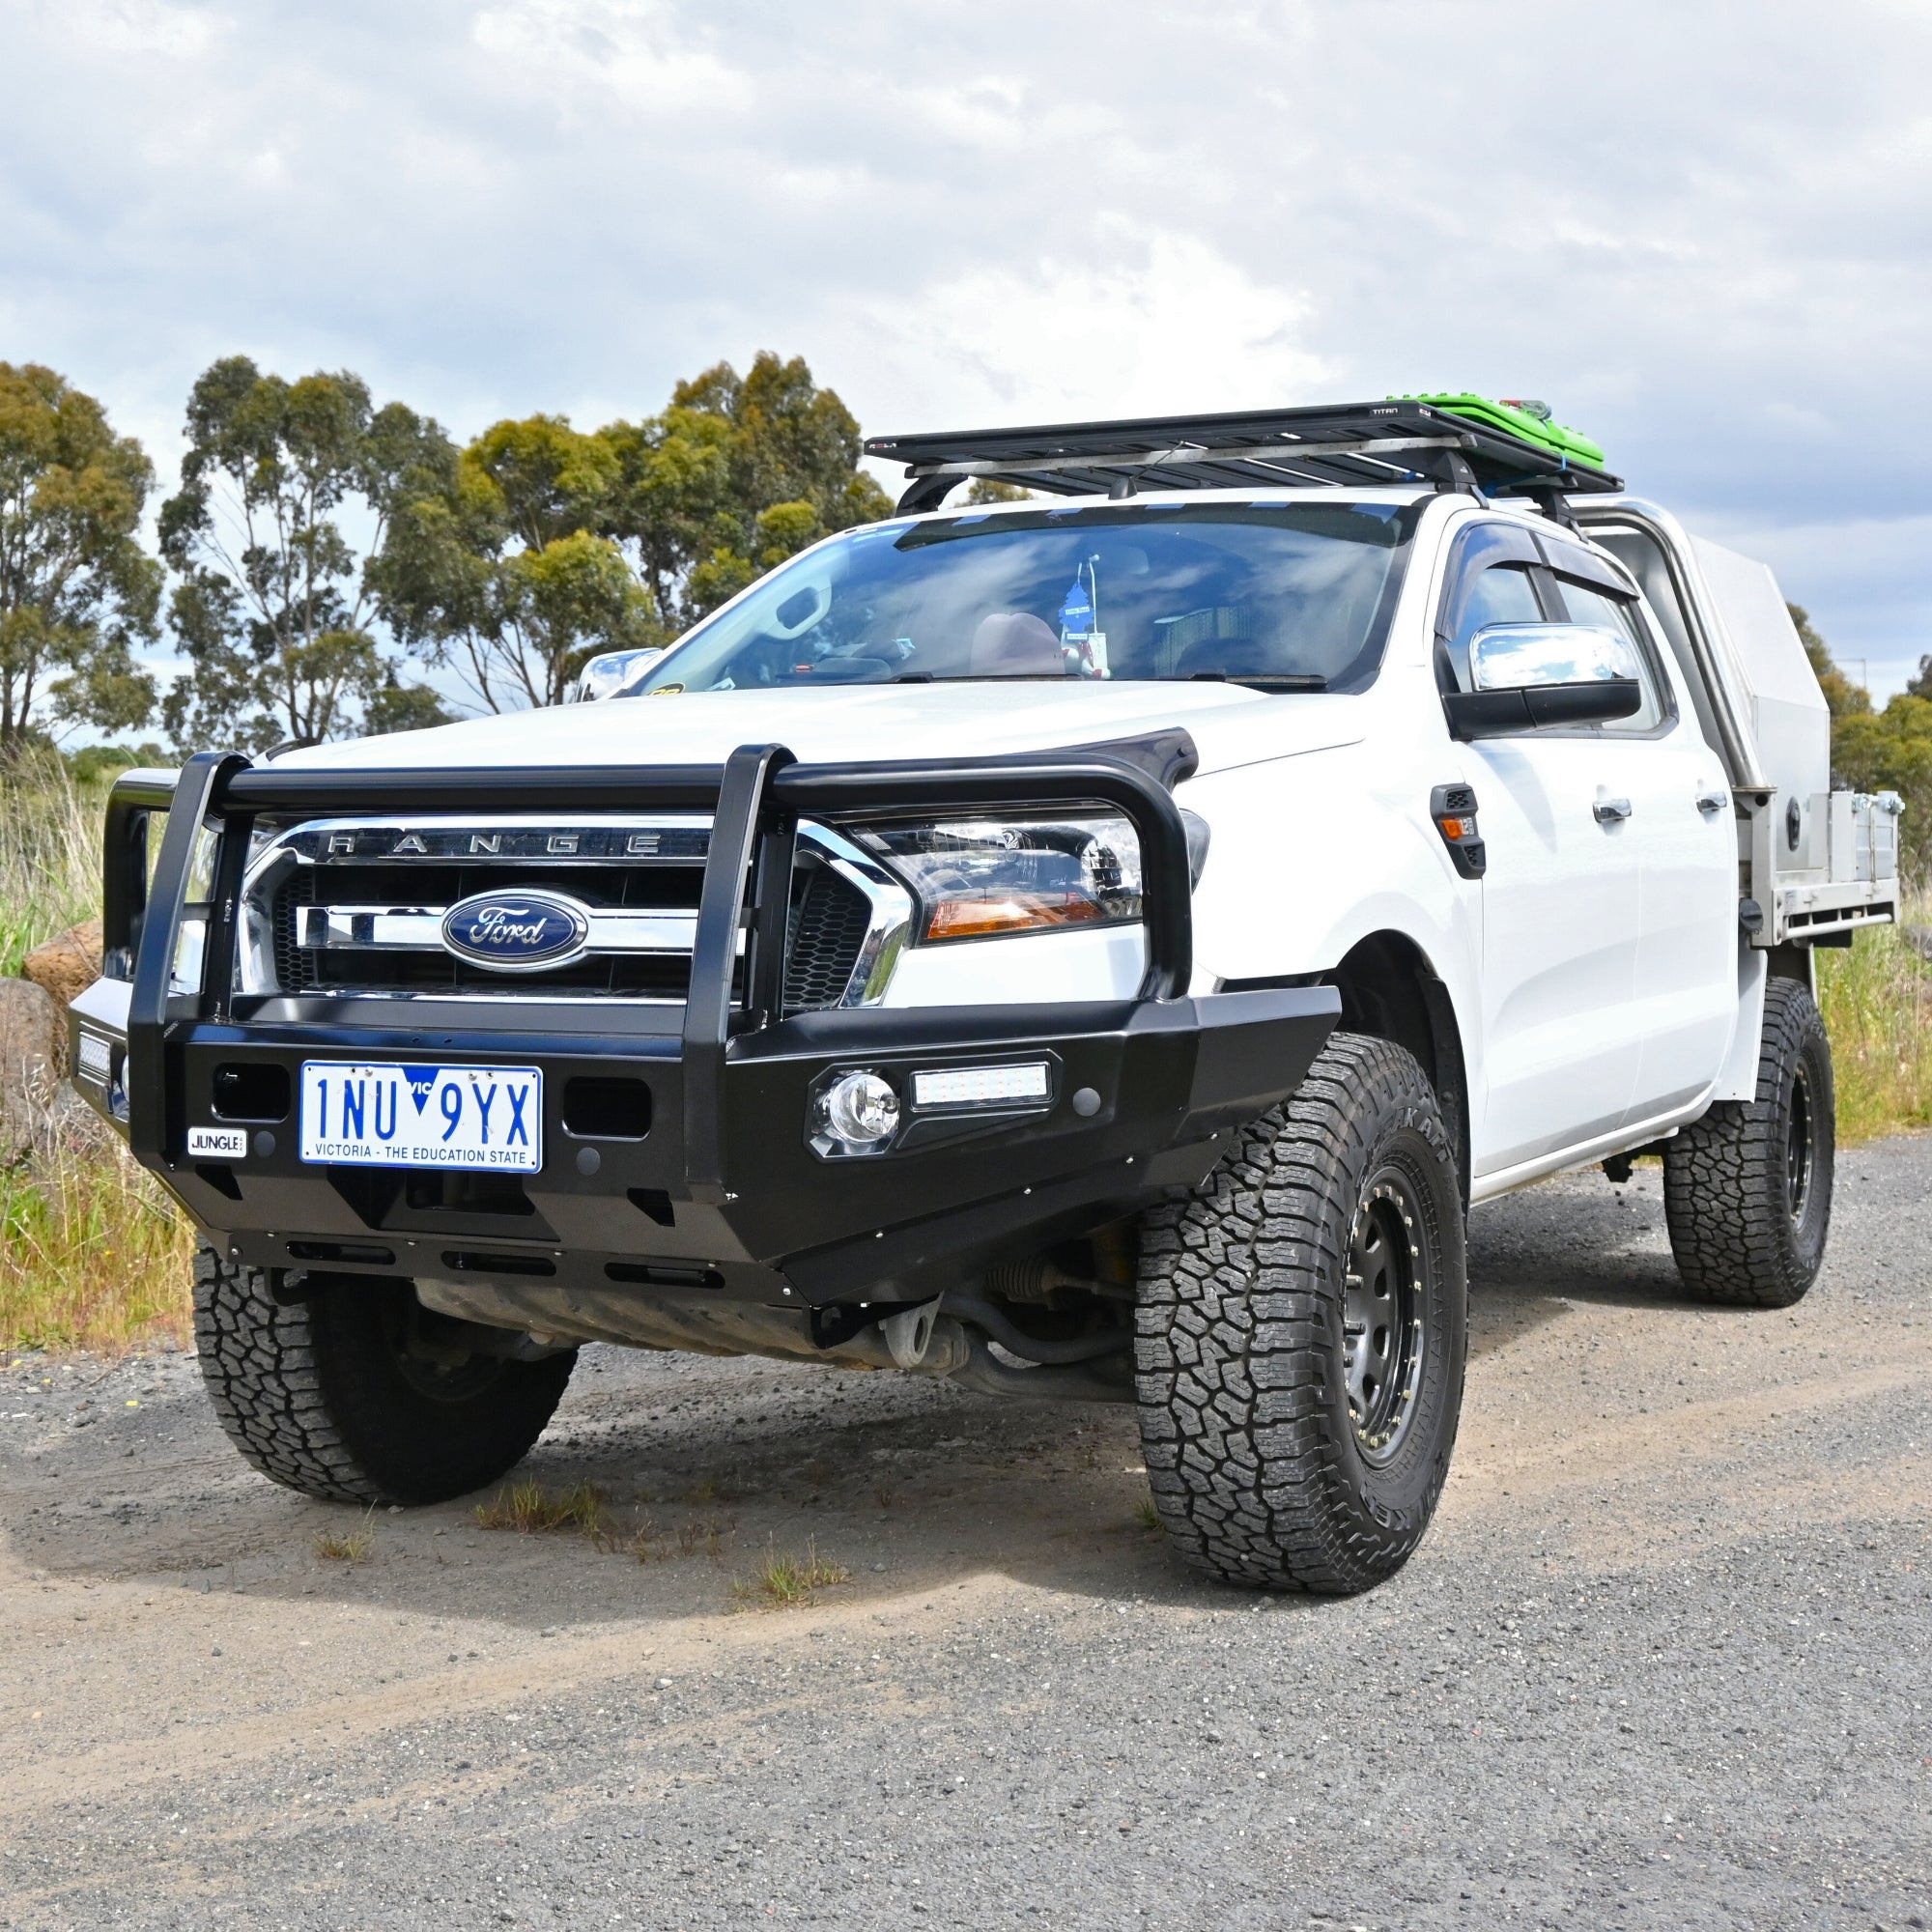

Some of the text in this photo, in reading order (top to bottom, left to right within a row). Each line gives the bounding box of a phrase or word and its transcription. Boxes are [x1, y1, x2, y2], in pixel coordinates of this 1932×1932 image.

[469, 906, 548, 945] Ford
[407, 1081, 433, 1094] VIC
[317, 1078, 529, 1146] 1NU 9YX
[191, 1135, 239, 1151] JUNGLE
[315, 1144, 372, 1157] VICTORIA
[385, 1146, 409, 1159] THE
[412, 1147, 486, 1162] EDUCATION
[490, 1151, 526, 1164] STATE
